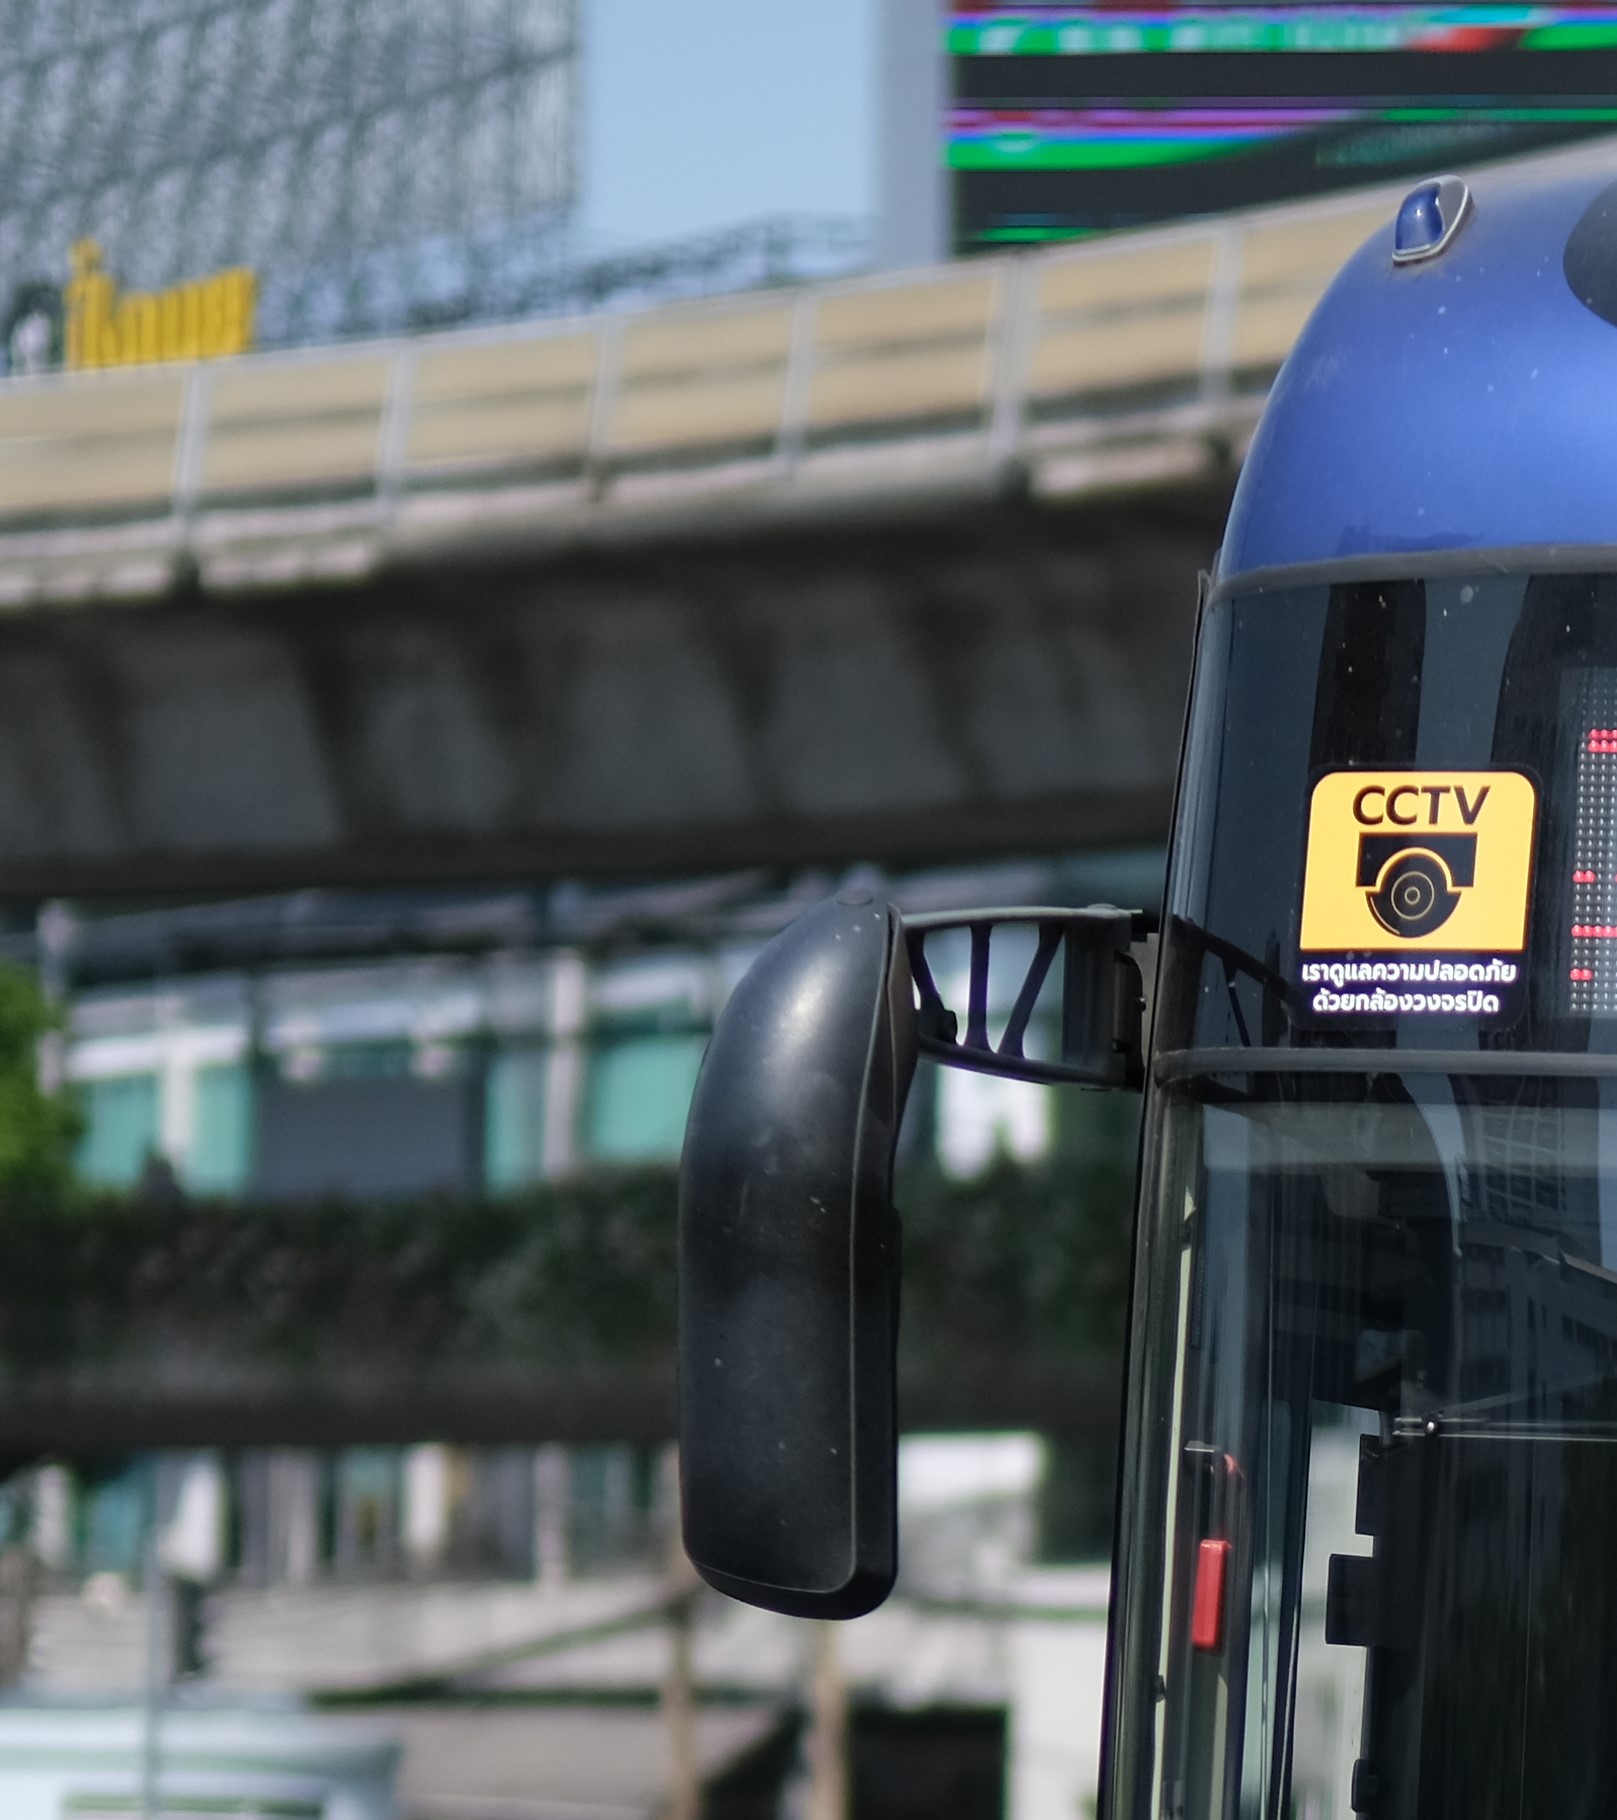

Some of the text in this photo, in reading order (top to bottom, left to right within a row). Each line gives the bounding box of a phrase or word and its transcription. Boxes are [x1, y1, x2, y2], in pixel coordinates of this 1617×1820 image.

[1352, 785, 1491, 826] CCTV
[1301, 957, 1517, 988] เราดูแลความปลอดภัย
[1312, 987, 1500, 1013] ด้วยกล้องวงจรปิด
